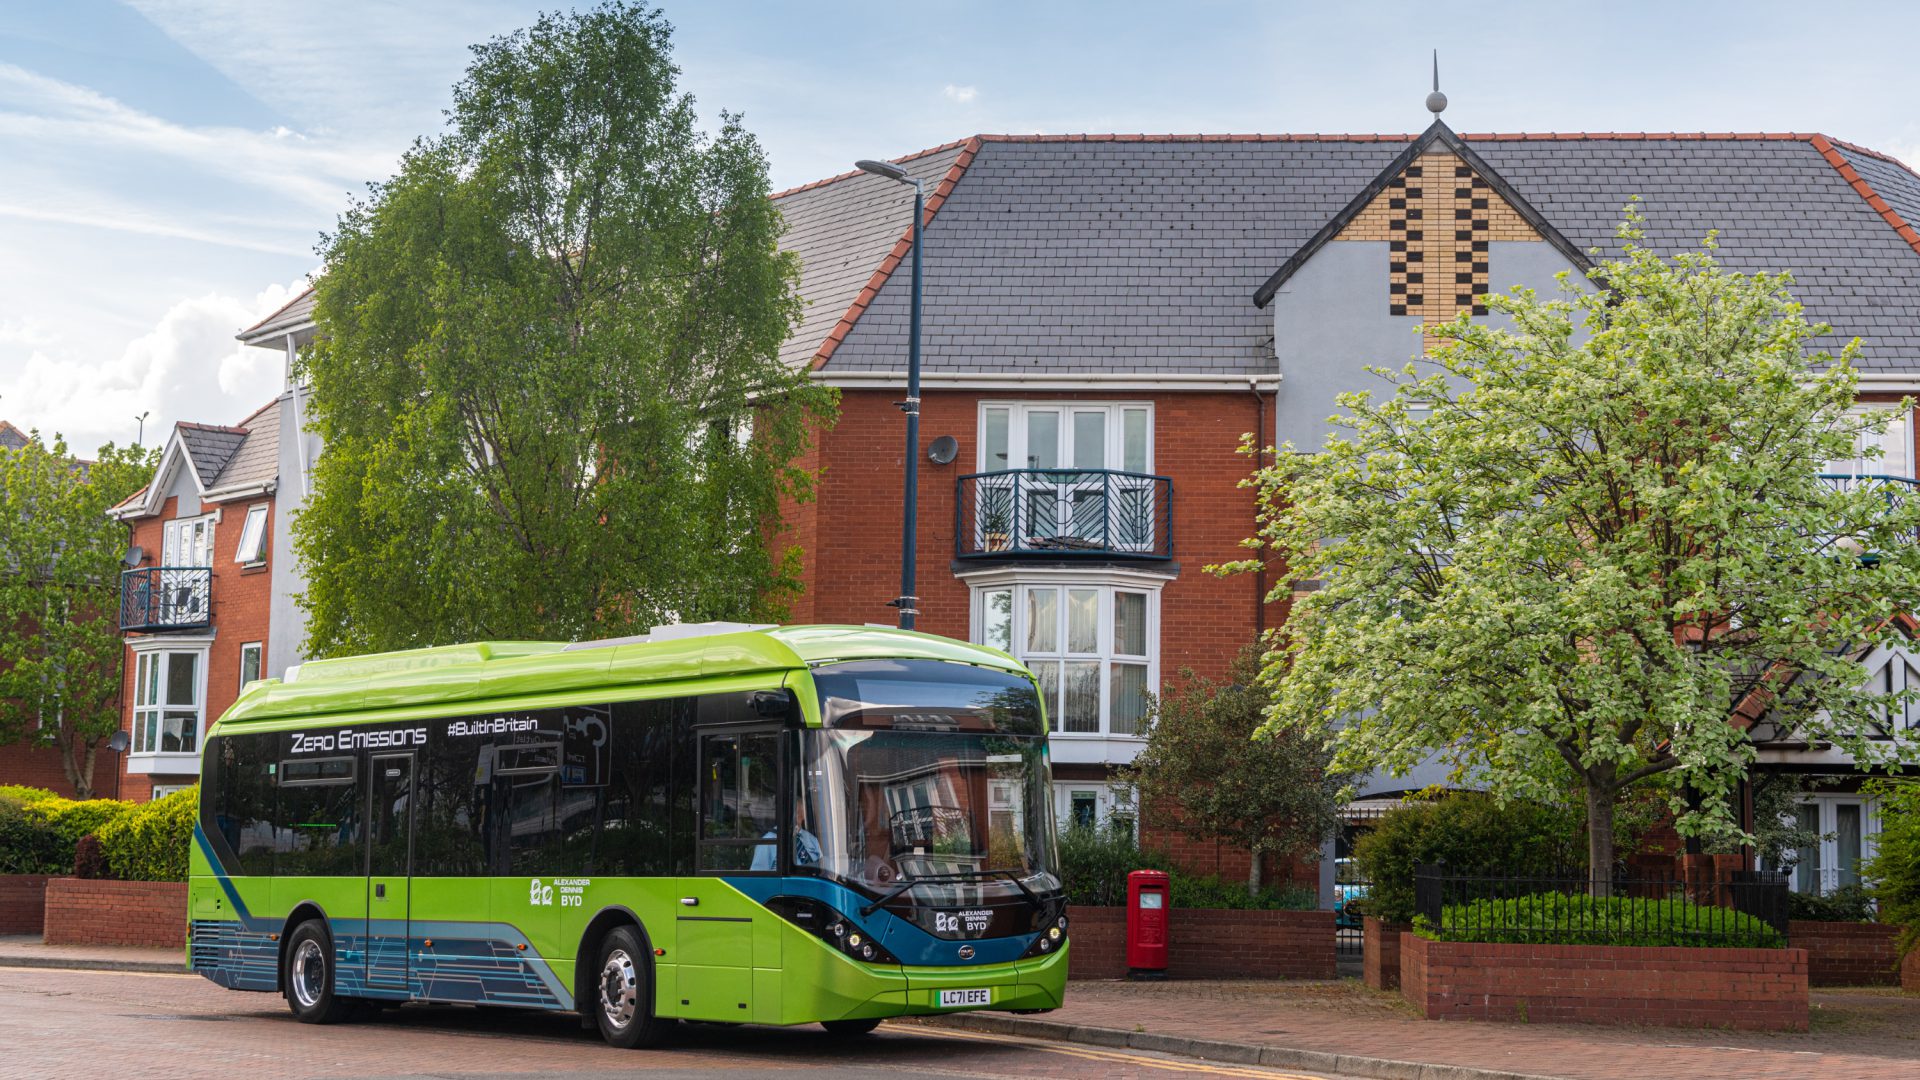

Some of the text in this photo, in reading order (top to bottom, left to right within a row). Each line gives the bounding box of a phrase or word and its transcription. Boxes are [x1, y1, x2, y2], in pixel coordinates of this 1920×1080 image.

[447, 716, 538, 737] #BuiltInBritain
[553, 878, 591, 886] ALEXANDER
[560, 886, 584, 894] DENNIS
[561, 895, 583, 907] BYD
[966, 921, 987, 931] BYD
[943, 990, 987, 1004] LC71 EFE
